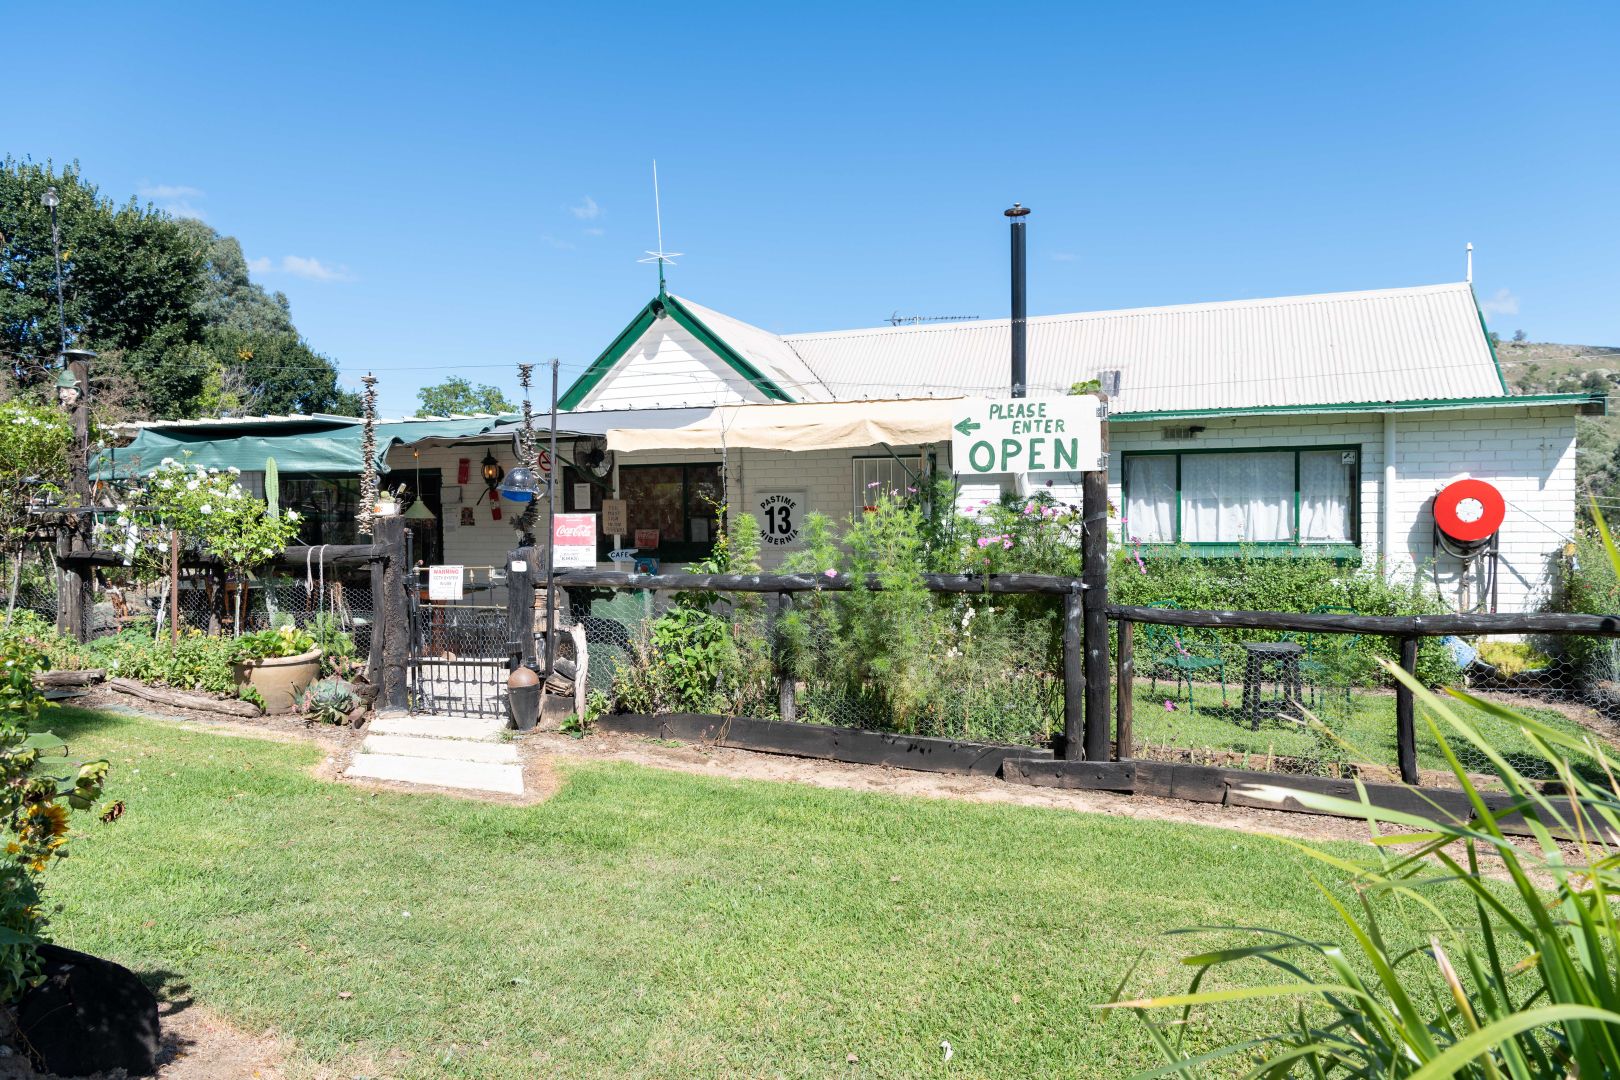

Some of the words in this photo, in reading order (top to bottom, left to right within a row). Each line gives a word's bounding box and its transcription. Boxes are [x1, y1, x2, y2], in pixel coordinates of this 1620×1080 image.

[989, 403, 1046, 420] PLEASE
[1012, 419, 1065, 434] ENTER
[969, 438, 1078, 472] OPEN
[760, 495, 796, 509] PASTIME
[765, 506, 791, 534] 13
[760, 530, 798, 545] HIBERNIA
